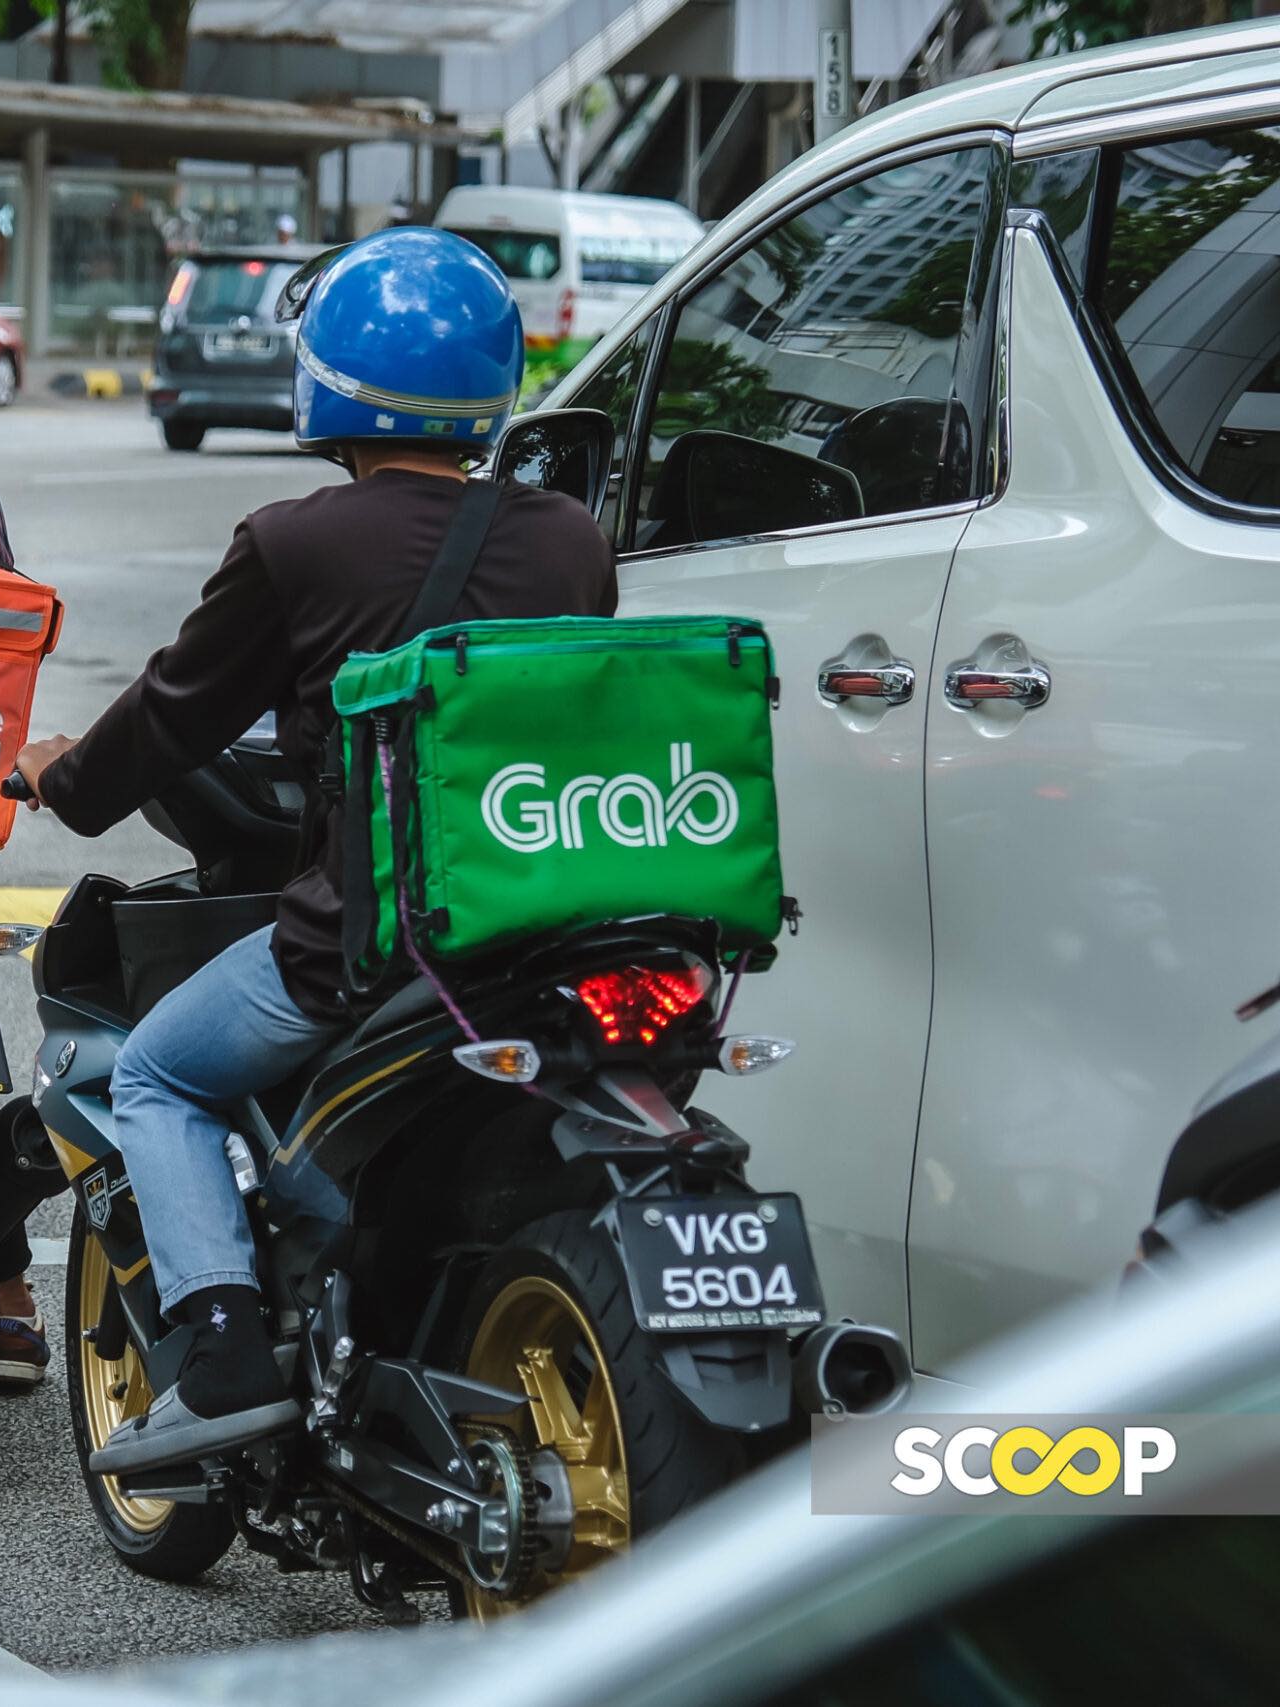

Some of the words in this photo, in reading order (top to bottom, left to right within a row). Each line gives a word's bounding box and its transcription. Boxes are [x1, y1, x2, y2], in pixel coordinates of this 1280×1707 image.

[827, 33, 841, 116] 158
[480, 742, 740, 854] Grab
[665, 1212, 768, 1256] VKG
[662, 1264, 798, 1309] 5604
